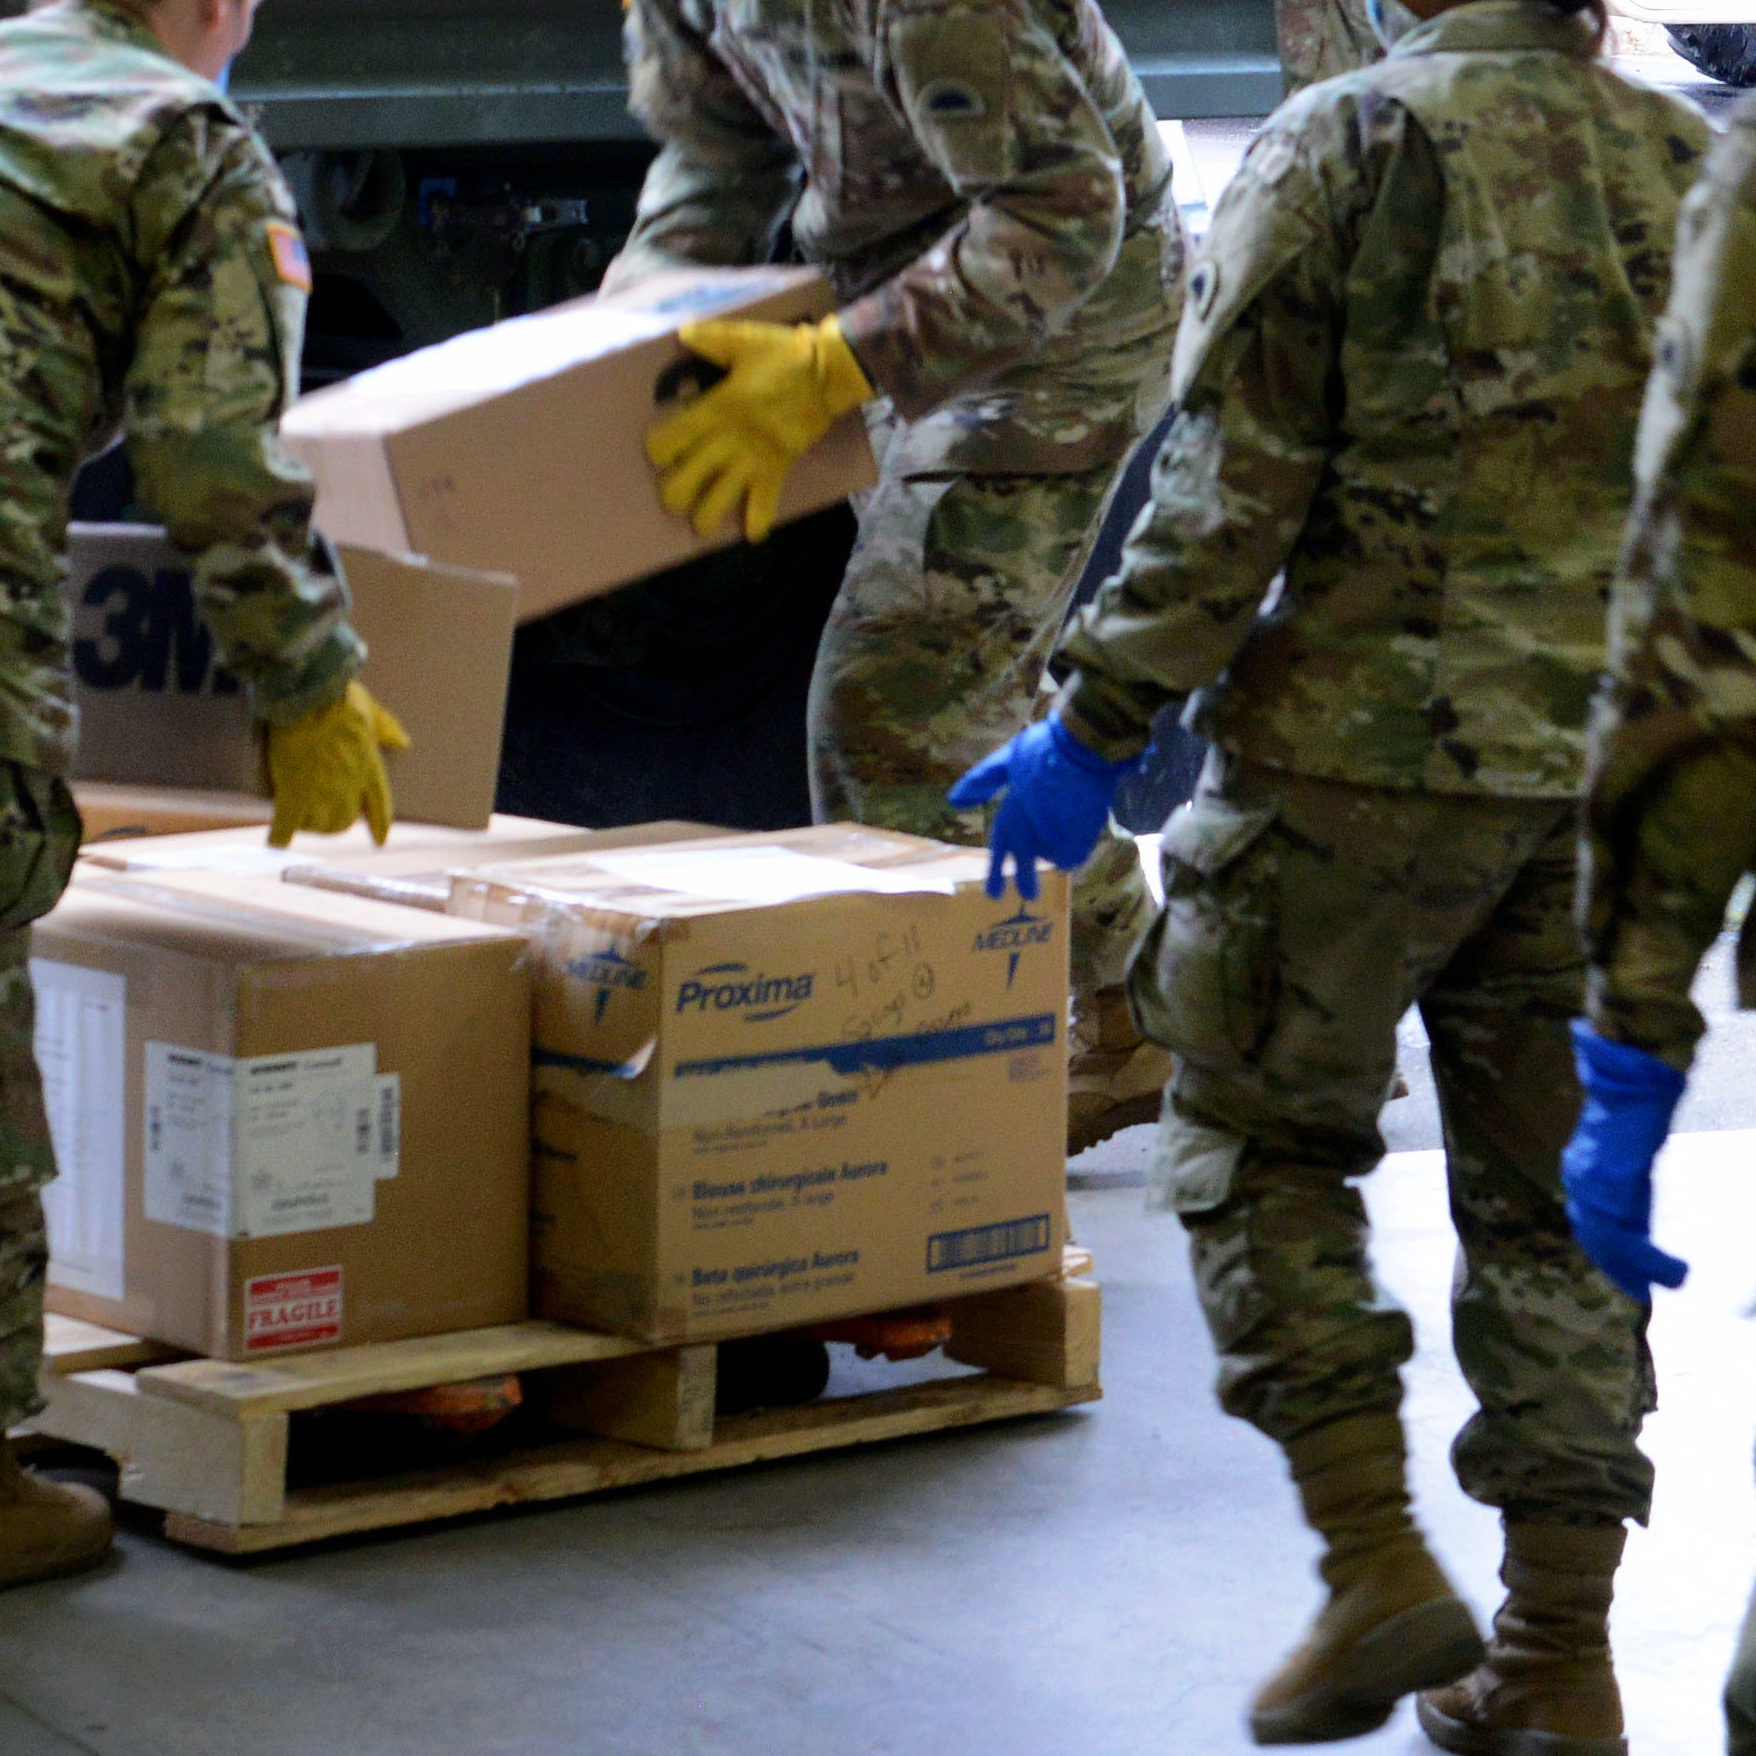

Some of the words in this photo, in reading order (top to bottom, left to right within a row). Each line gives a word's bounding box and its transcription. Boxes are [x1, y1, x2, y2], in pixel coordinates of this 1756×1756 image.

[974, 923, 1053, 951] MEDLINE
[676, 972, 814, 1013] Proxima
[248, 1299, 338, 1331] FRAGILE
